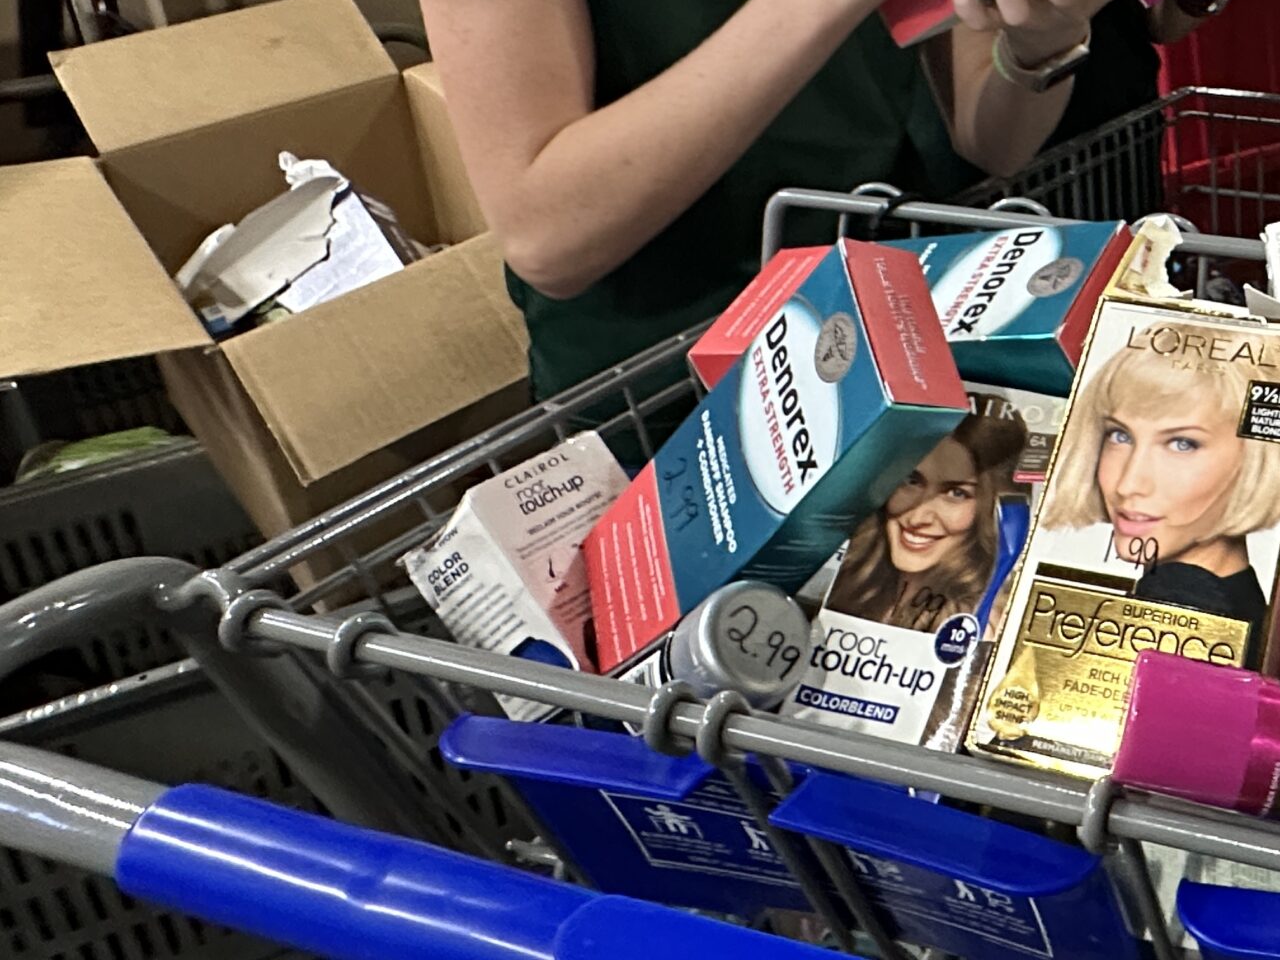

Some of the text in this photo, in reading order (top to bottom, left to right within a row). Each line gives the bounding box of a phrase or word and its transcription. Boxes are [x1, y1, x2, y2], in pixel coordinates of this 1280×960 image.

[951, 231, 1044, 335] Denorex
[766, 313, 818, 484] Denorex
[752, 346, 796, 496] EXTRA STRENGTH
[504, 453, 569, 489] CLAIROL
[516, 479, 547, 501] root
[519, 474, 585, 515] touch-up
[427, 551, 463, 586] COLOR
[1104, 530, 1159, 574] 1.99
[433, 562, 470, 596] BLEND
[727, 605, 800, 681] 2.99
[826, 627, 888, 658] root
[950, 628, 966, 643] 10
[1027, 591, 1236, 664] Preference
[810, 646, 936, 696] touch-up
[1089, 668, 1120, 684] RICH
[799, 688, 896, 722] COLORBLEND
[1004, 689, 1029, 701] HIGH
